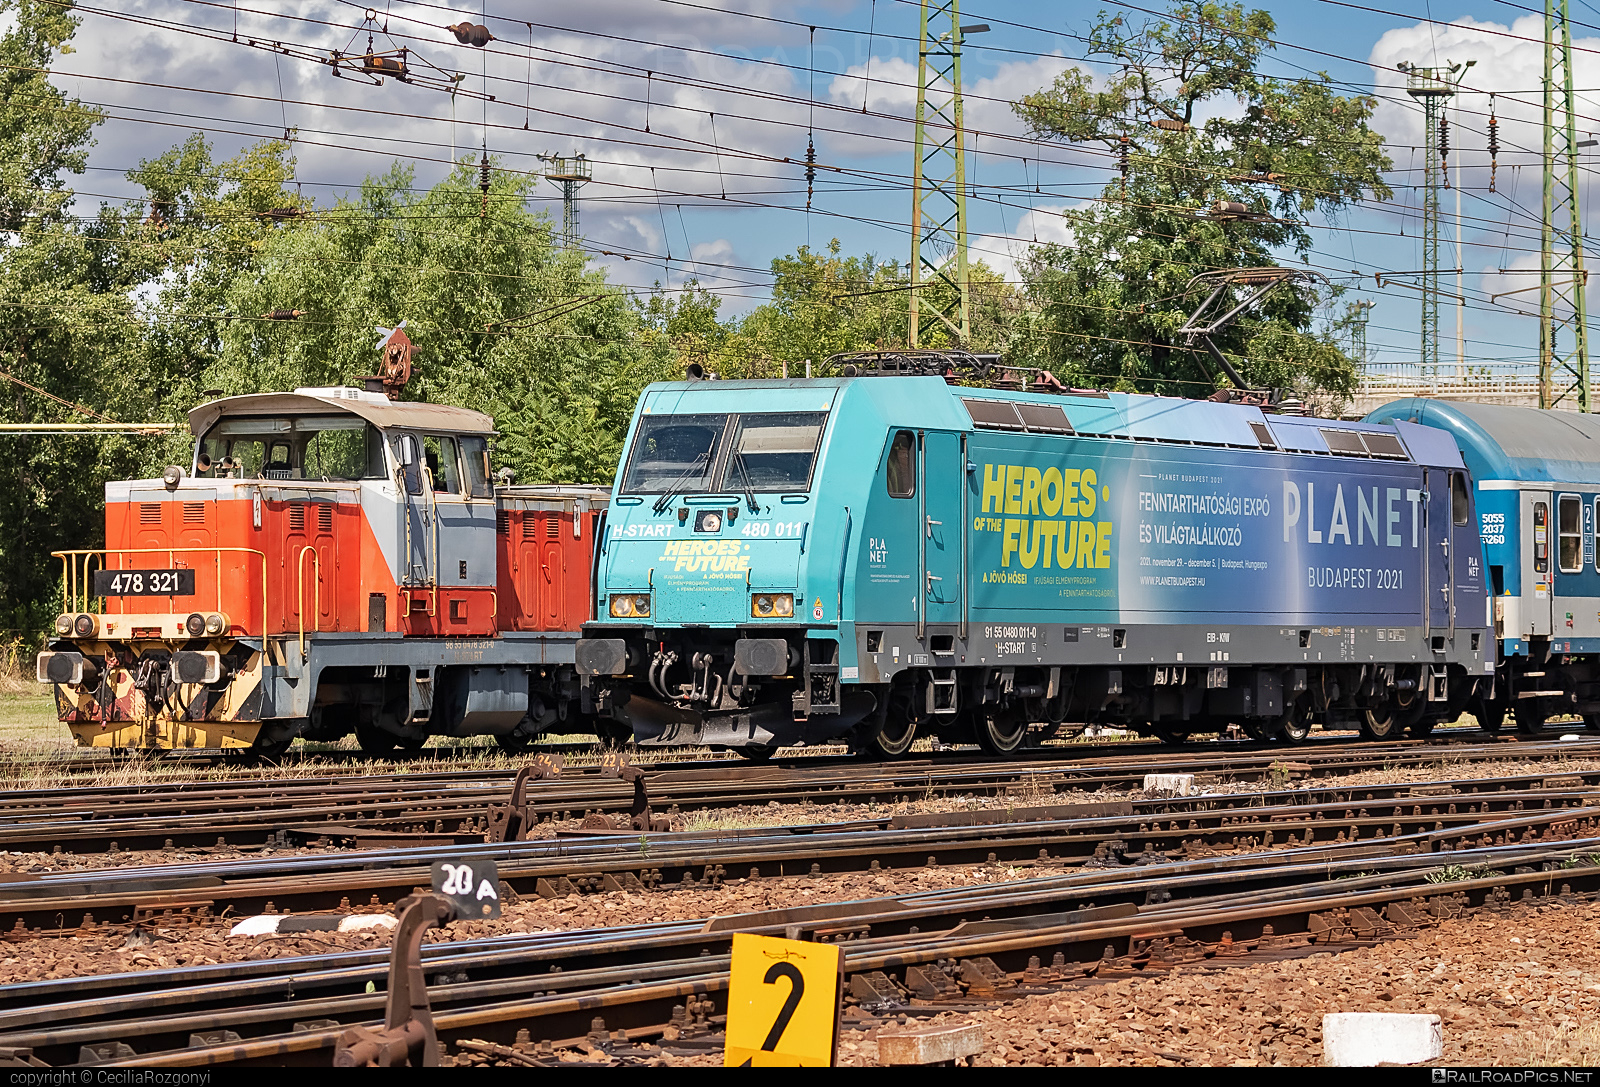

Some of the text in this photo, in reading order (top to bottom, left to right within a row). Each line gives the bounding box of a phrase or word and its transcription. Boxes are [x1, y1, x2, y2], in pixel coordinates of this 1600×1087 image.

[1158, 473, 1179, 481] PLANET
[982, 464, 1097, 518] HEROES
[1139, 491, 1270, 516] FENNTARTHATÓSÁGI EXPÓ
[1282, 480, 1426, 548] PLANET
[1482, 514, 1504, 524] 5055
[1585, 508, 1591, 524] 2
[612, 524, 674, 538] H-START
[741, 522, 802, 537] 480 011
[974, 517, 1002, 532] OF THE
[1482, 524, 1504, 534] 2037
[1139, 520, 1242, 546] ÉS VILÁGTALÁLKOZÓ
[664, 540, 742, 555] HEROES
[870, 538, 886, 550] PLA
[1001, 518, 1112, 570] FUTURE
[674, 556, 750, 572] FUTURE
[870, 551, 887, 562] NET
[1140, 557, 1152, 566] 2021.
[1152, 558, 1176, 566] november
[1188, 558, 1211, 568] december
[1212, 558, 1216, 568] 5.
[1222, 559, 1244, 570] Budapest,
[1245, 560, 1268, 570] Hungexpo
[1468, 556, 1478, 566] PLA
[982, 572, 988, 583] A
[1308, 567, 1403, 590] BUDAPEST 2021
[1468, 566, 1479, 576] NET
[110, 572, 178, 593] 478 321
[1140, 576, 1206, 586] WWW.PLANETBUDAPEST.HU
[912, 596, 916, 612] 1
[984, 626, 1037, 638] 91 55 0480 011-0
[603, 754, 616, 767] 22
[441, 864, 498, 900] 20 A
[760, 961, 804, 1052] 2
